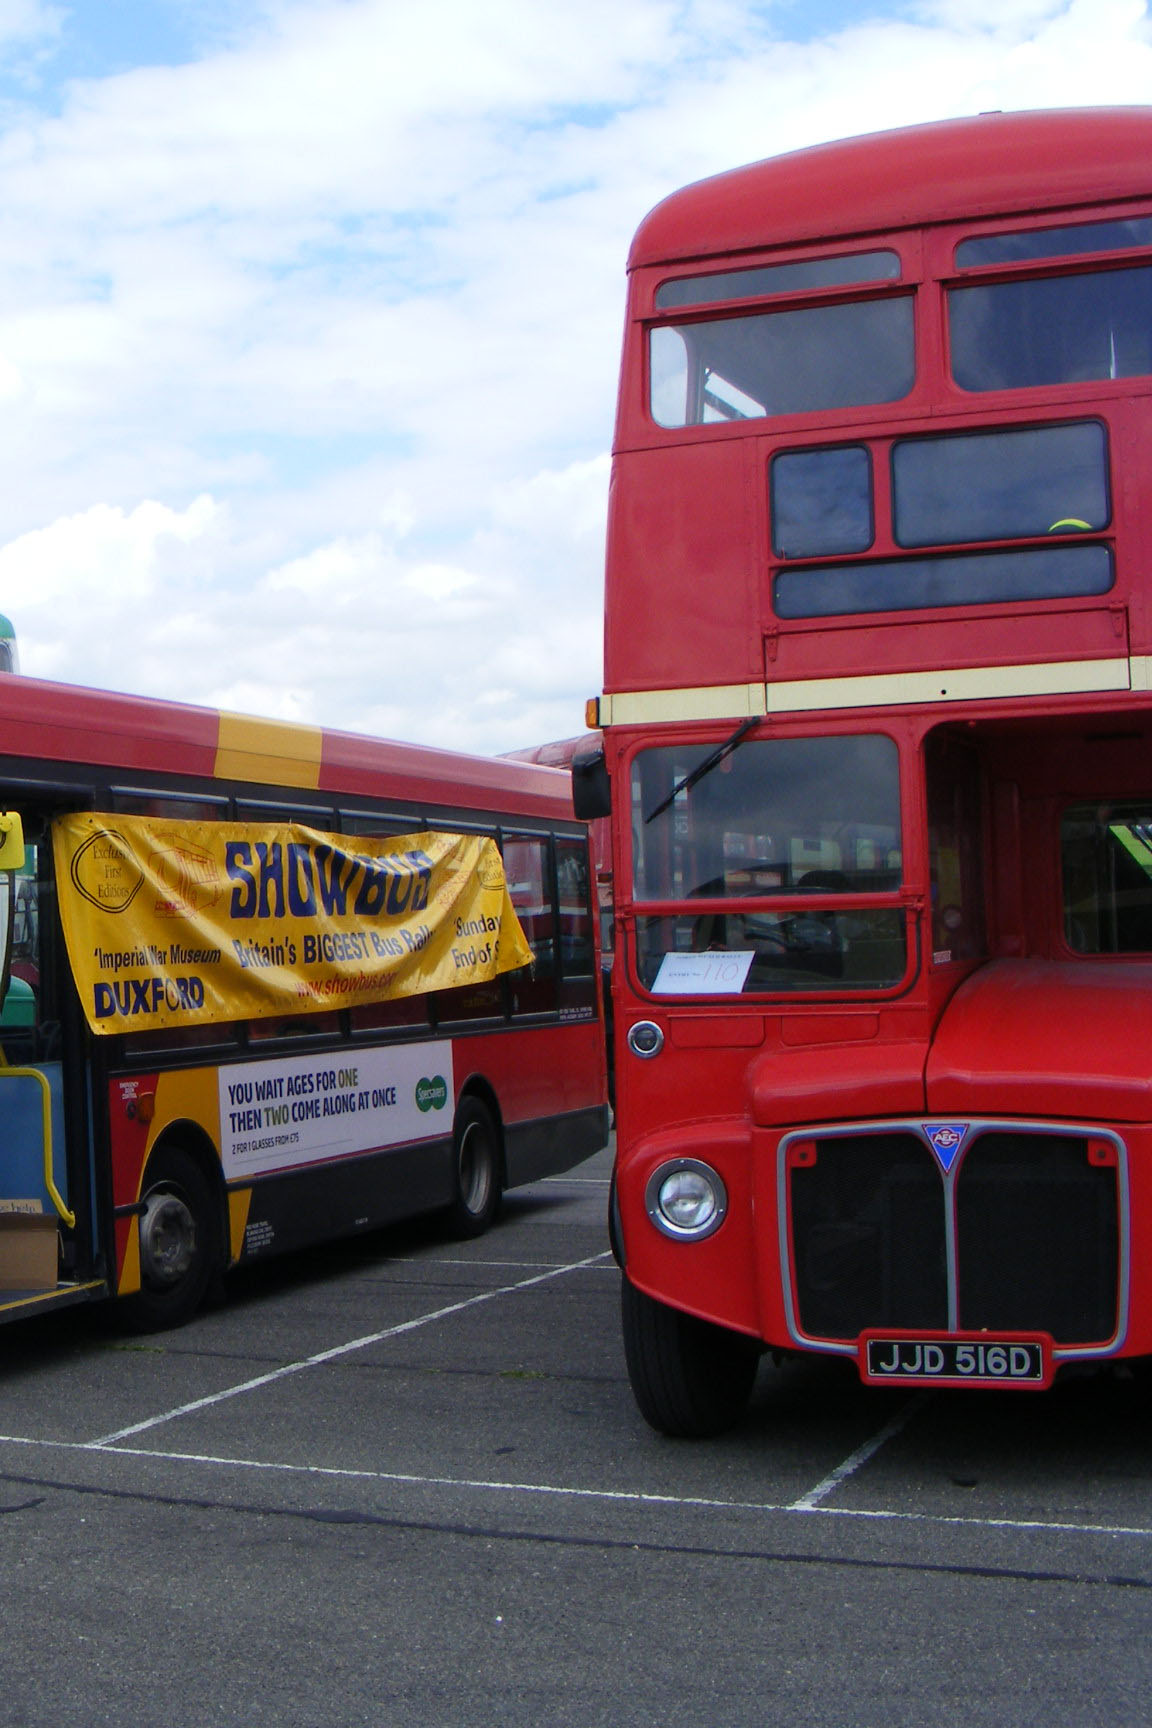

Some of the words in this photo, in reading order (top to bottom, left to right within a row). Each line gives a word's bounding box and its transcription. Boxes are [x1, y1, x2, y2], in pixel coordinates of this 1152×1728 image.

[225, 841, 434, 918] SHOWBUS
[170, 944, 221, 965] Museum
[232, 937, 297, 968] Britain's
[303, 932, 370, 964] BIGGEST
[370, 931, 404, 957] Bus
[451, 946, 477, 969] End
[478, 942, 493, 964] of
[93, 976, 205, 1019] DUXFORD
[227, 1083, 253, 1106] YOU
[254, 1077, 284, 1101] WAIT
[286, 1073, 314, 1096] AGES
[316, 1070, 337, 1091] FOR
[338, 1068, 359, 1089] ONE
[229, 1108, 262, 1133] THEN
[264, 1103, 290, 1126] TWO
[291, 1098, 321, 1123] COME
[323, 1092, 356, 1117] ALONG
[358, 1091, 370, 1111] AT
[372, 1087, 397, 1108] ONCE
[231, 1144, 237, 1155] 2
[237, 1142, 248, 1154] FOR
[252, 1137, 275, 1151] GLASSES
[275, 1134, 290, 1148] FROM
[933, 1132, 959, 1143] AEC
[879, 1344, 945, 1374] JJD
[955, 1345, 1031, 1376] 516D
